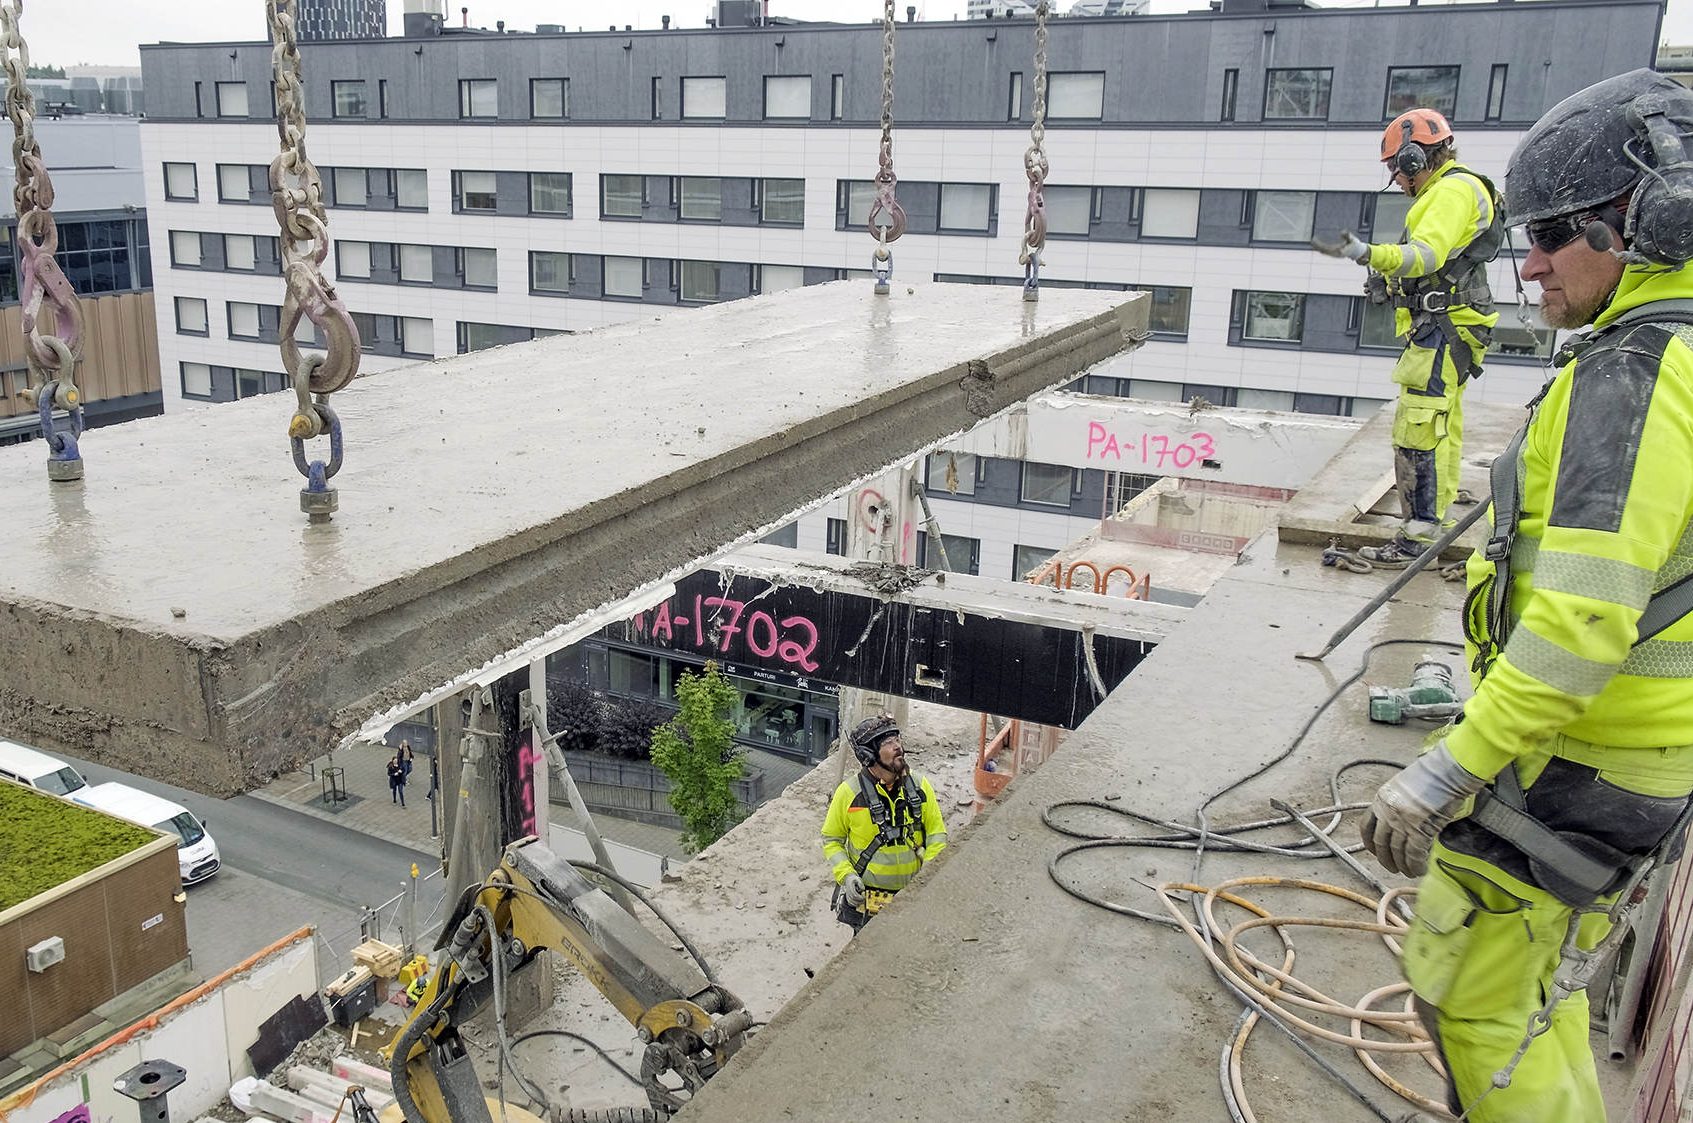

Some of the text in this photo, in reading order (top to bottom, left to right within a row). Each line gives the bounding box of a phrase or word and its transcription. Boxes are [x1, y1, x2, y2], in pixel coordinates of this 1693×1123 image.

[1087, 421, 1215, 468] PA-1703
[634, 594, 819, 672] A-1702
[753, 671, 776, 680] PARTURI
